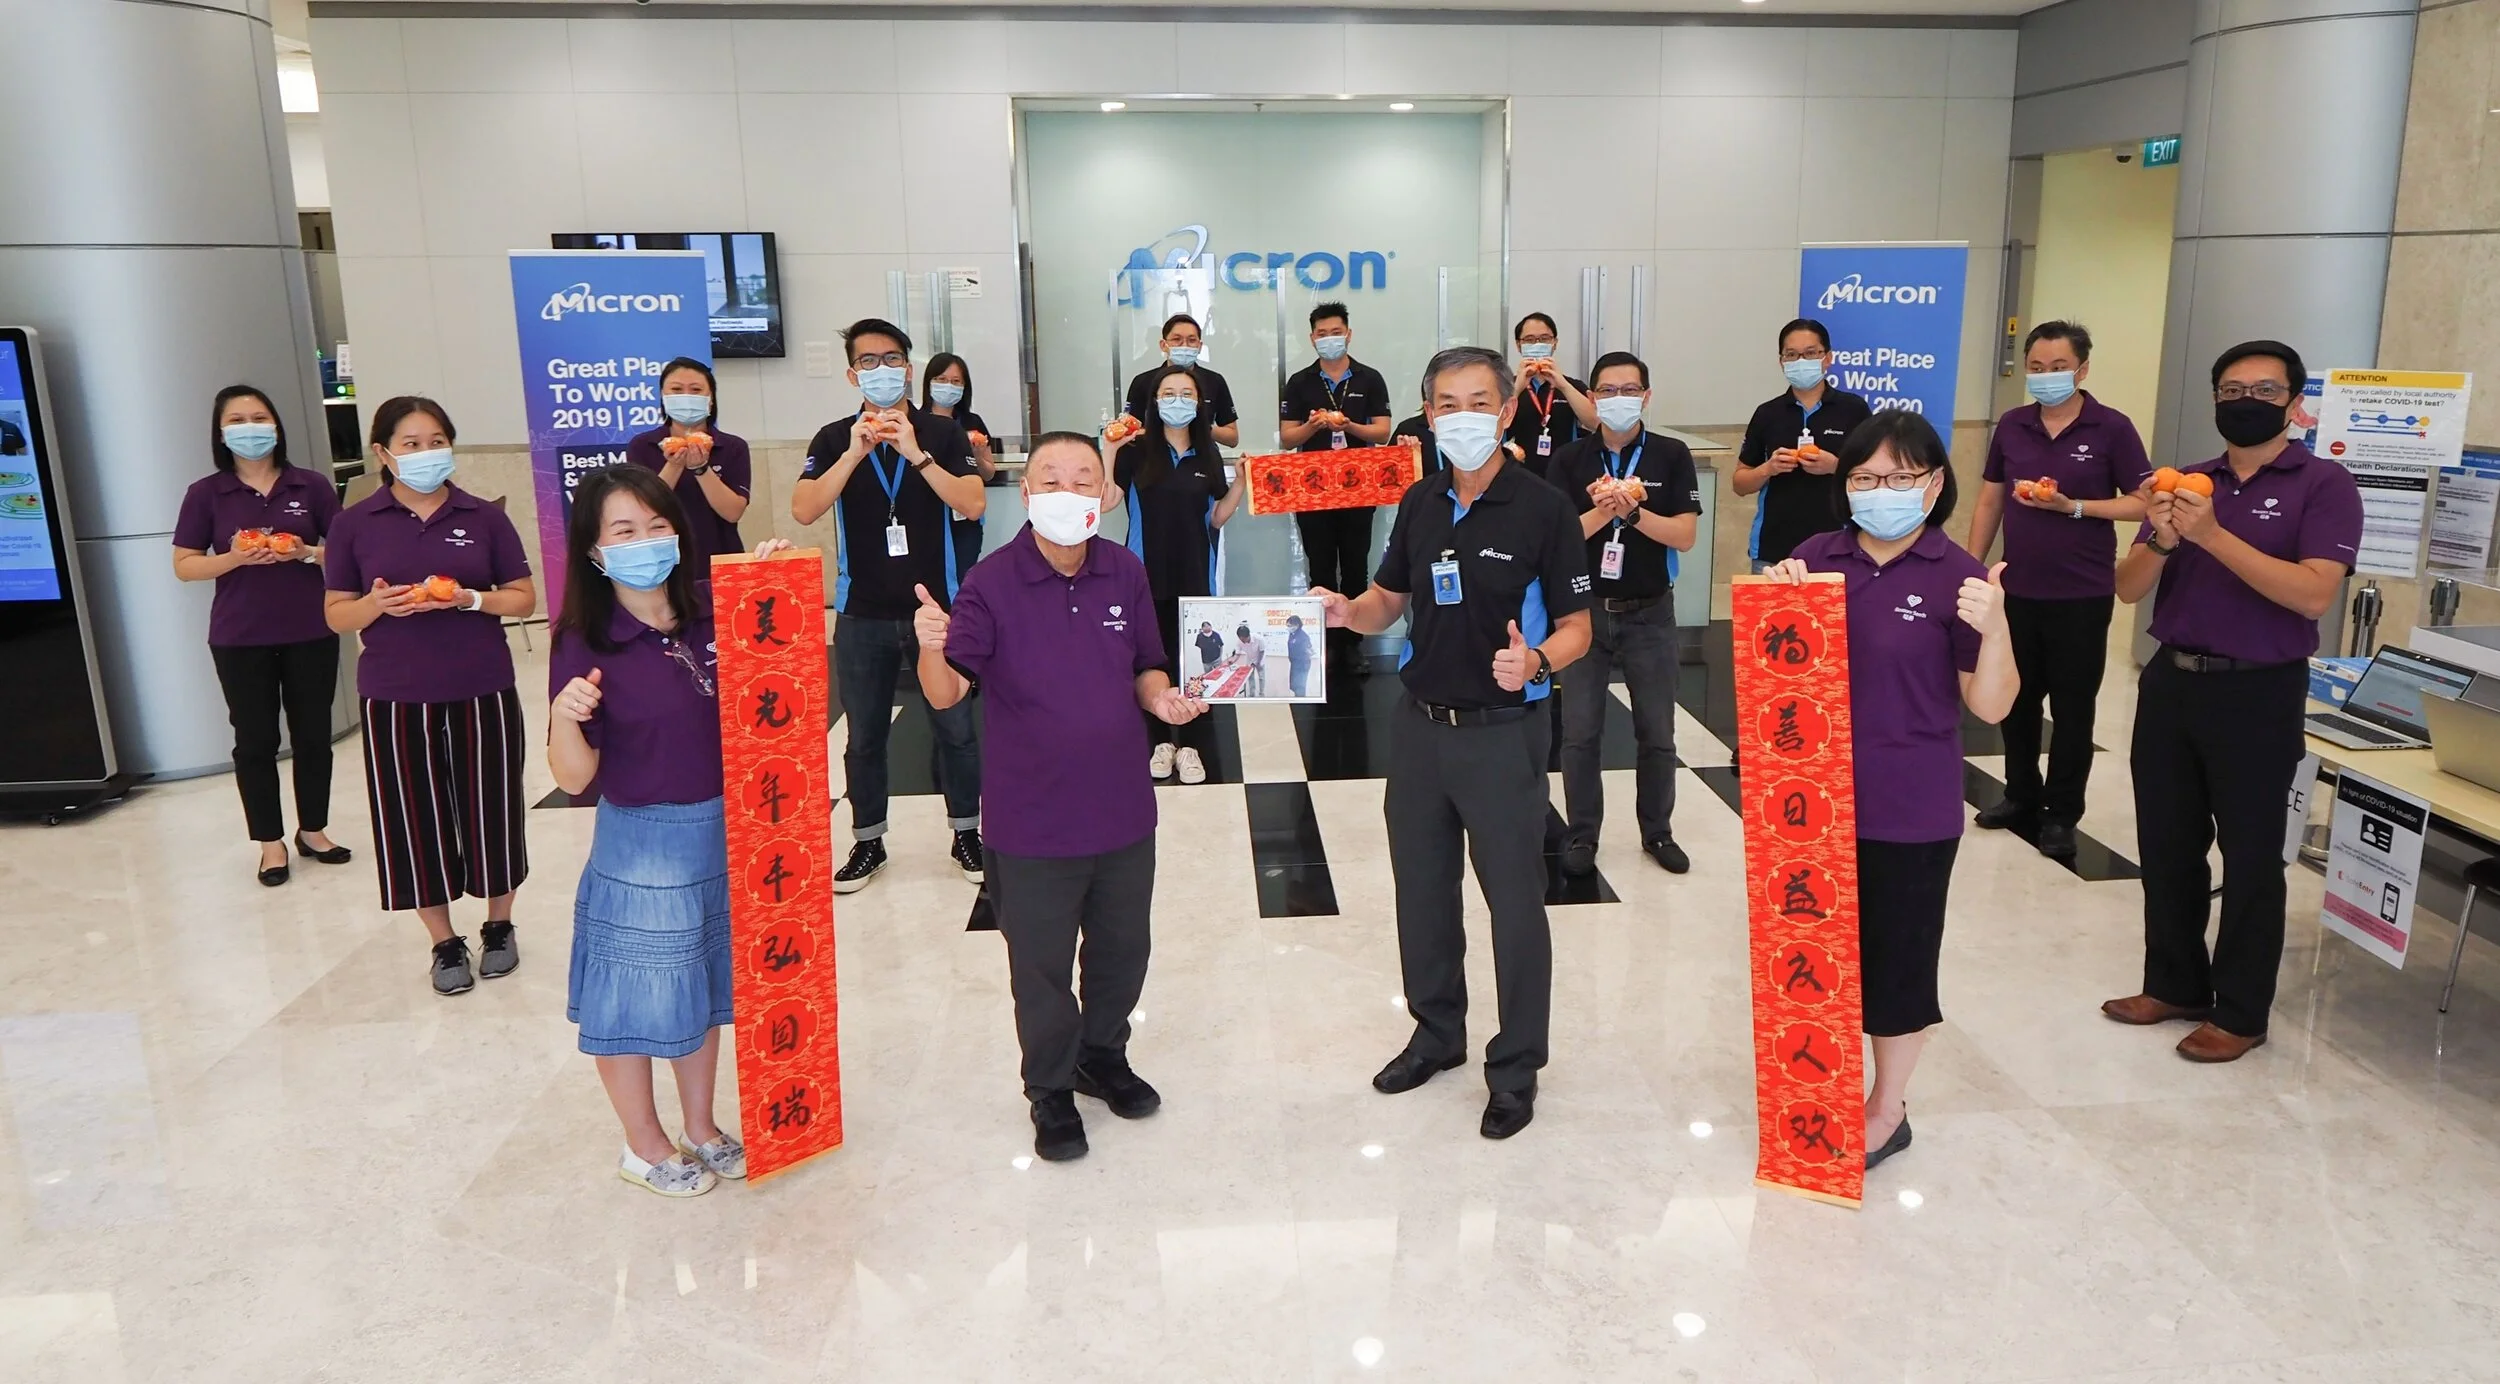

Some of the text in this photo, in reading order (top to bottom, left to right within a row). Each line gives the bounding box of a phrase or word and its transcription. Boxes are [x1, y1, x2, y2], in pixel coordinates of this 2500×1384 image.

[2151, 139, 2177, 162] EXIT
[541, 282, 681, 321] Micron
[1817, 273, 1937, 310] Micron
[547, 357, 671, 379] Great Pla
[1831, 347, 1936, 369] reat Place
[1845, 371, 1899, 393] Work
[2339, 374, 2388, 383] ATTENTION
[548, 381, 656, 404] To Work
[2341, 387, 2457, 400] Are you called by local authority
[2385, 397, 2422, 407] COVID-19
[2424, 399, 2445, 407] test?
[552, 407, 612, 429] 2019
[562, 453, 606, 469] Best
[2346, 461, 2427, 474] Health Declarations
[564, 471, 580, 487] &
[1478, 547, 1514, 562] Micron
[2365, 794, 2396, 813] COVID-19
